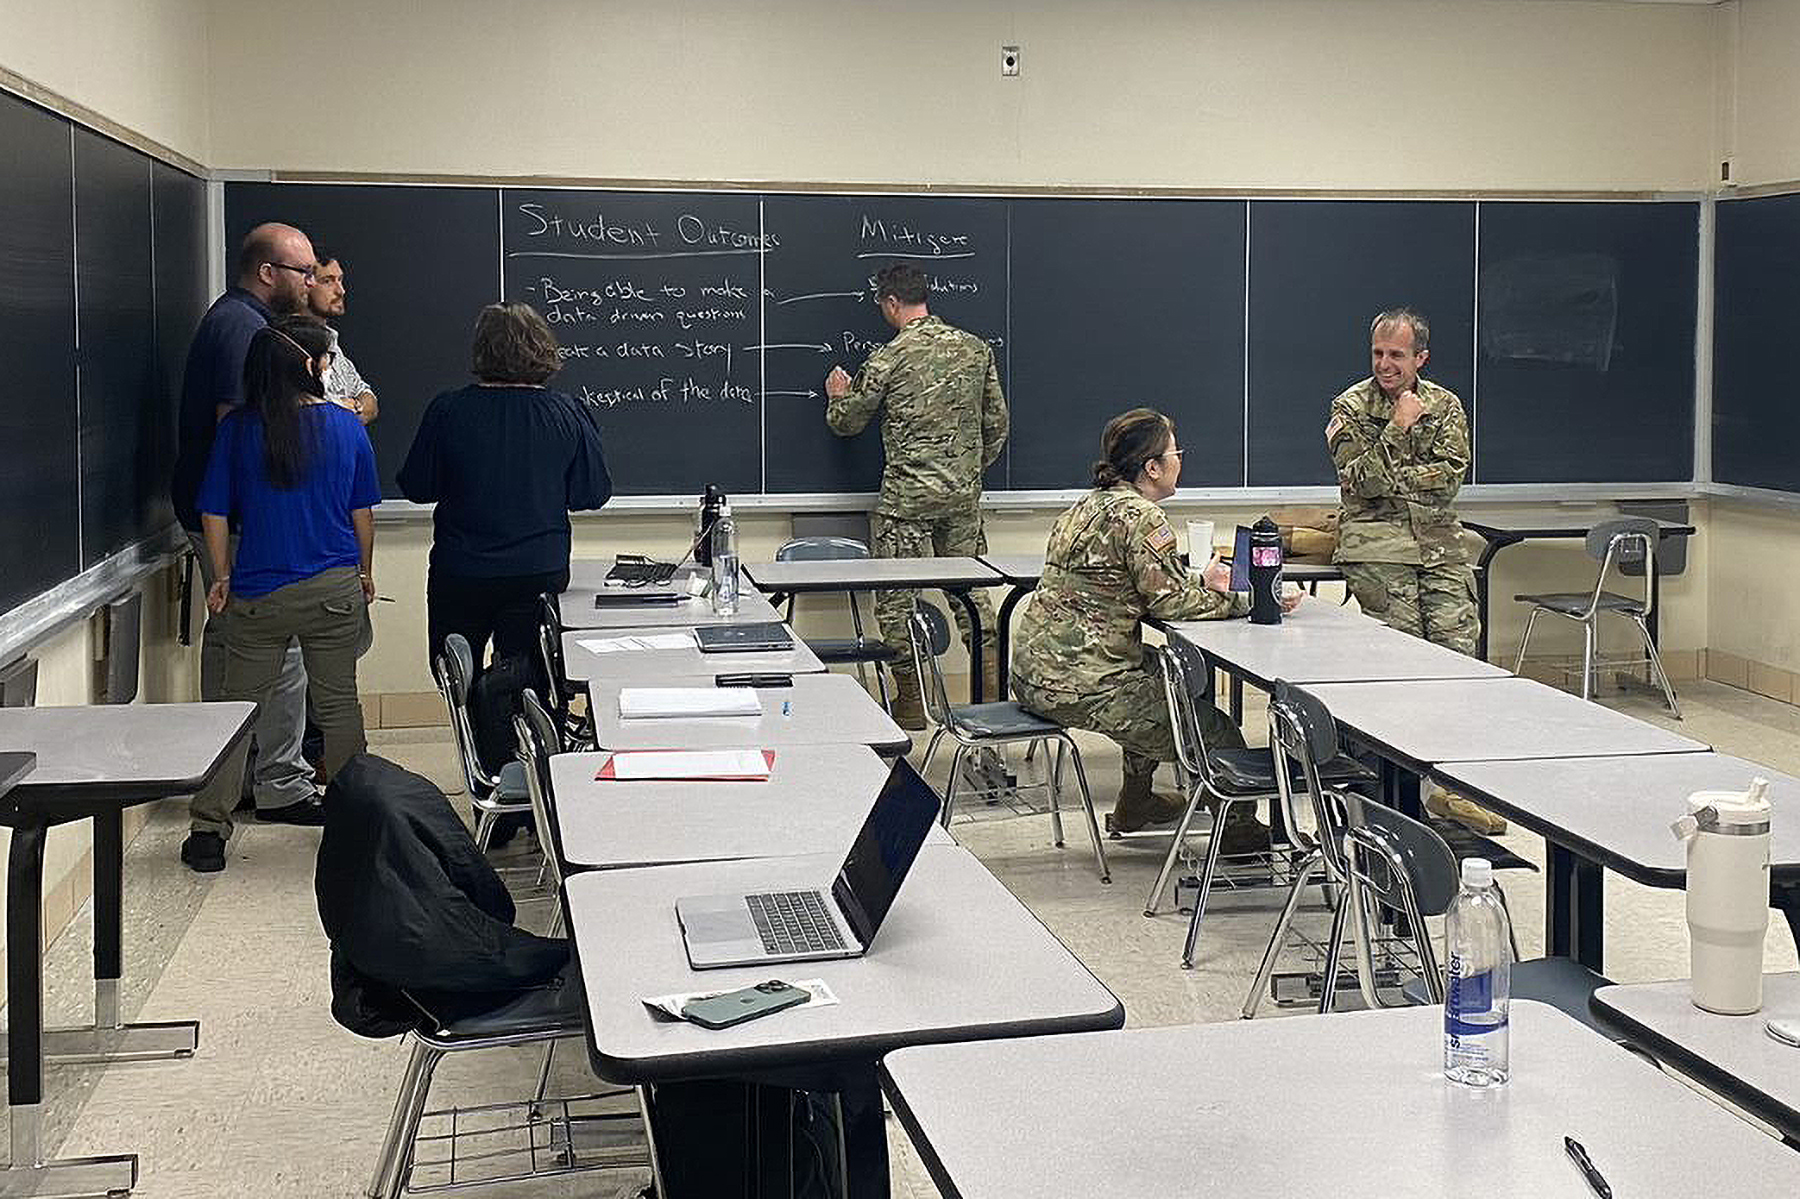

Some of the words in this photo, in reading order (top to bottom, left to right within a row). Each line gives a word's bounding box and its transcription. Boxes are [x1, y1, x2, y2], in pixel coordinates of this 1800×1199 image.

[519, 203, 661, 246] Student
[677, 215, 782, 248] Outcomes
[861, 215, 968, 256] Mitigate
[605, 279, 656, 301] able
[660, 284, 686, 298] to
[700, 278, 748, 299] make
[547, 306, 598, 325] data
[676, 307, 744, 329] questions
[596, 343, 610, 358] a
[616, 342, 665, 359] data
[651, 378, 674, 401] of
[680, 377, 712, 403] the
